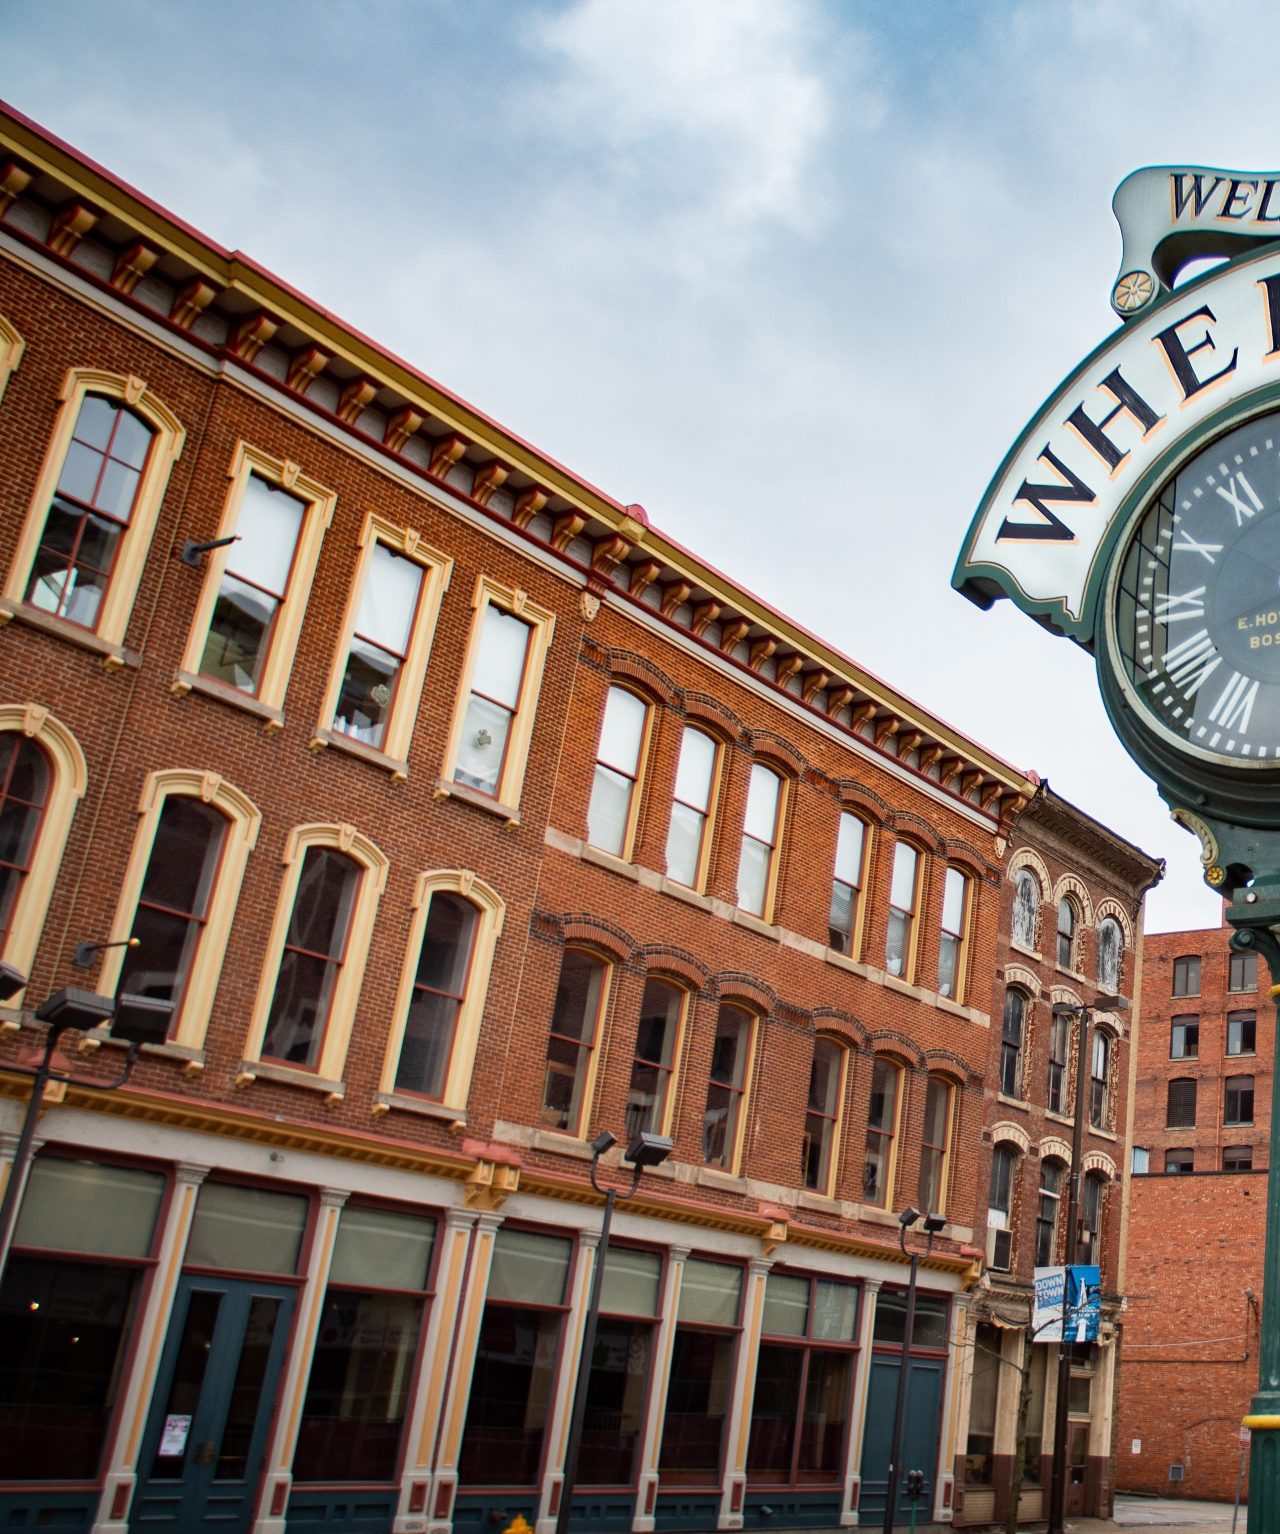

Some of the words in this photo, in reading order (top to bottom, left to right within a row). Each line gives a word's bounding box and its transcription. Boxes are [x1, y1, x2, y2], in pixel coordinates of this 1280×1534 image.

[1216, 471, 1264, 528] XI
[1171, 529, 1224, 565] X
[1154, 585, 1207, 625] IX
[1208, 671, 1260, 735] VII
[1035, 1276, 1063, 1290] DOWN
[1038, 1286, 1064, 1300] TOWN
